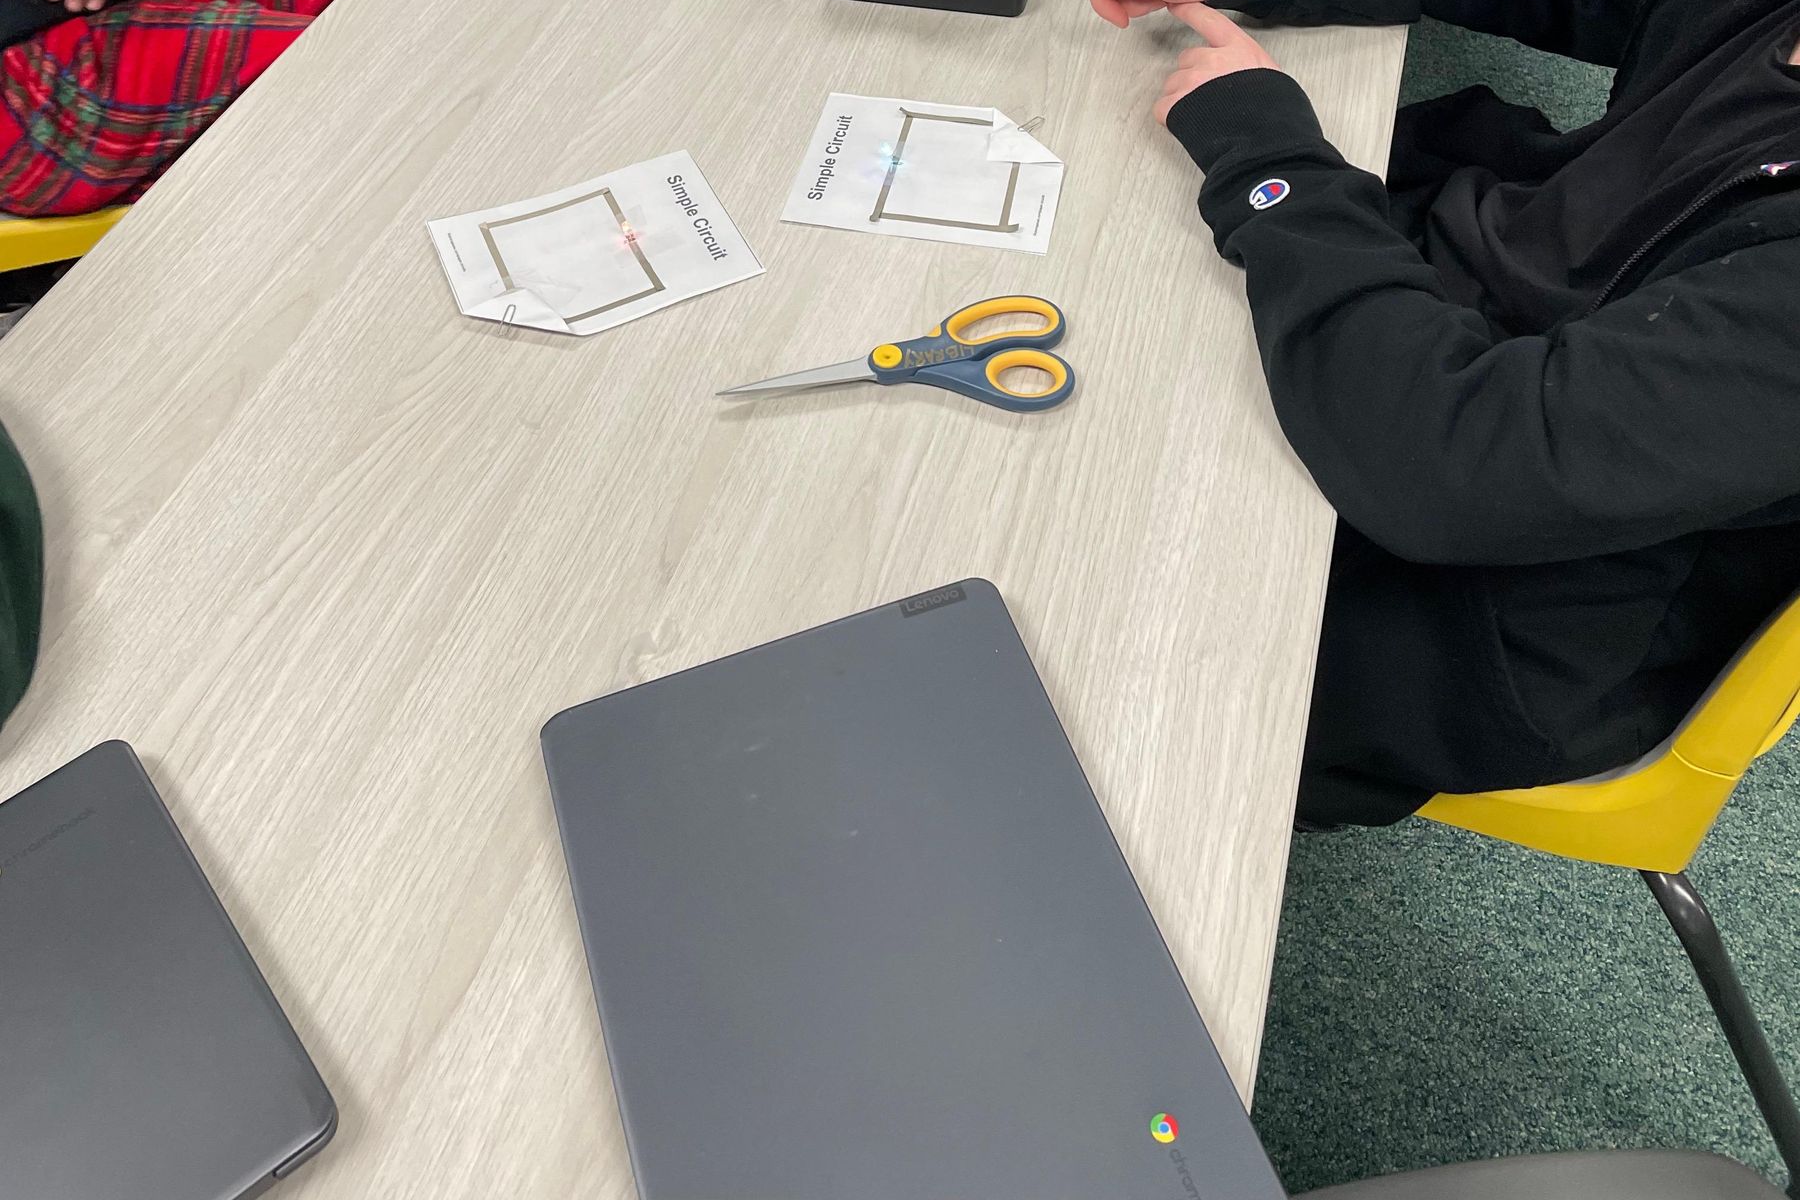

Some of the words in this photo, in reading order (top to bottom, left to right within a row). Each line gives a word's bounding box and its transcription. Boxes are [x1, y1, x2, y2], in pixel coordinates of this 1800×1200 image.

[807, 158, 836, 201] Simple
[825, 115, 853, 155] Circuit
[667, 174, 699, 217] Simple
[693, 218, 728, 261] Circuit
[904, 344, 976, 369] LIBRARY
[905, 589, 960, 613] Lenovo
